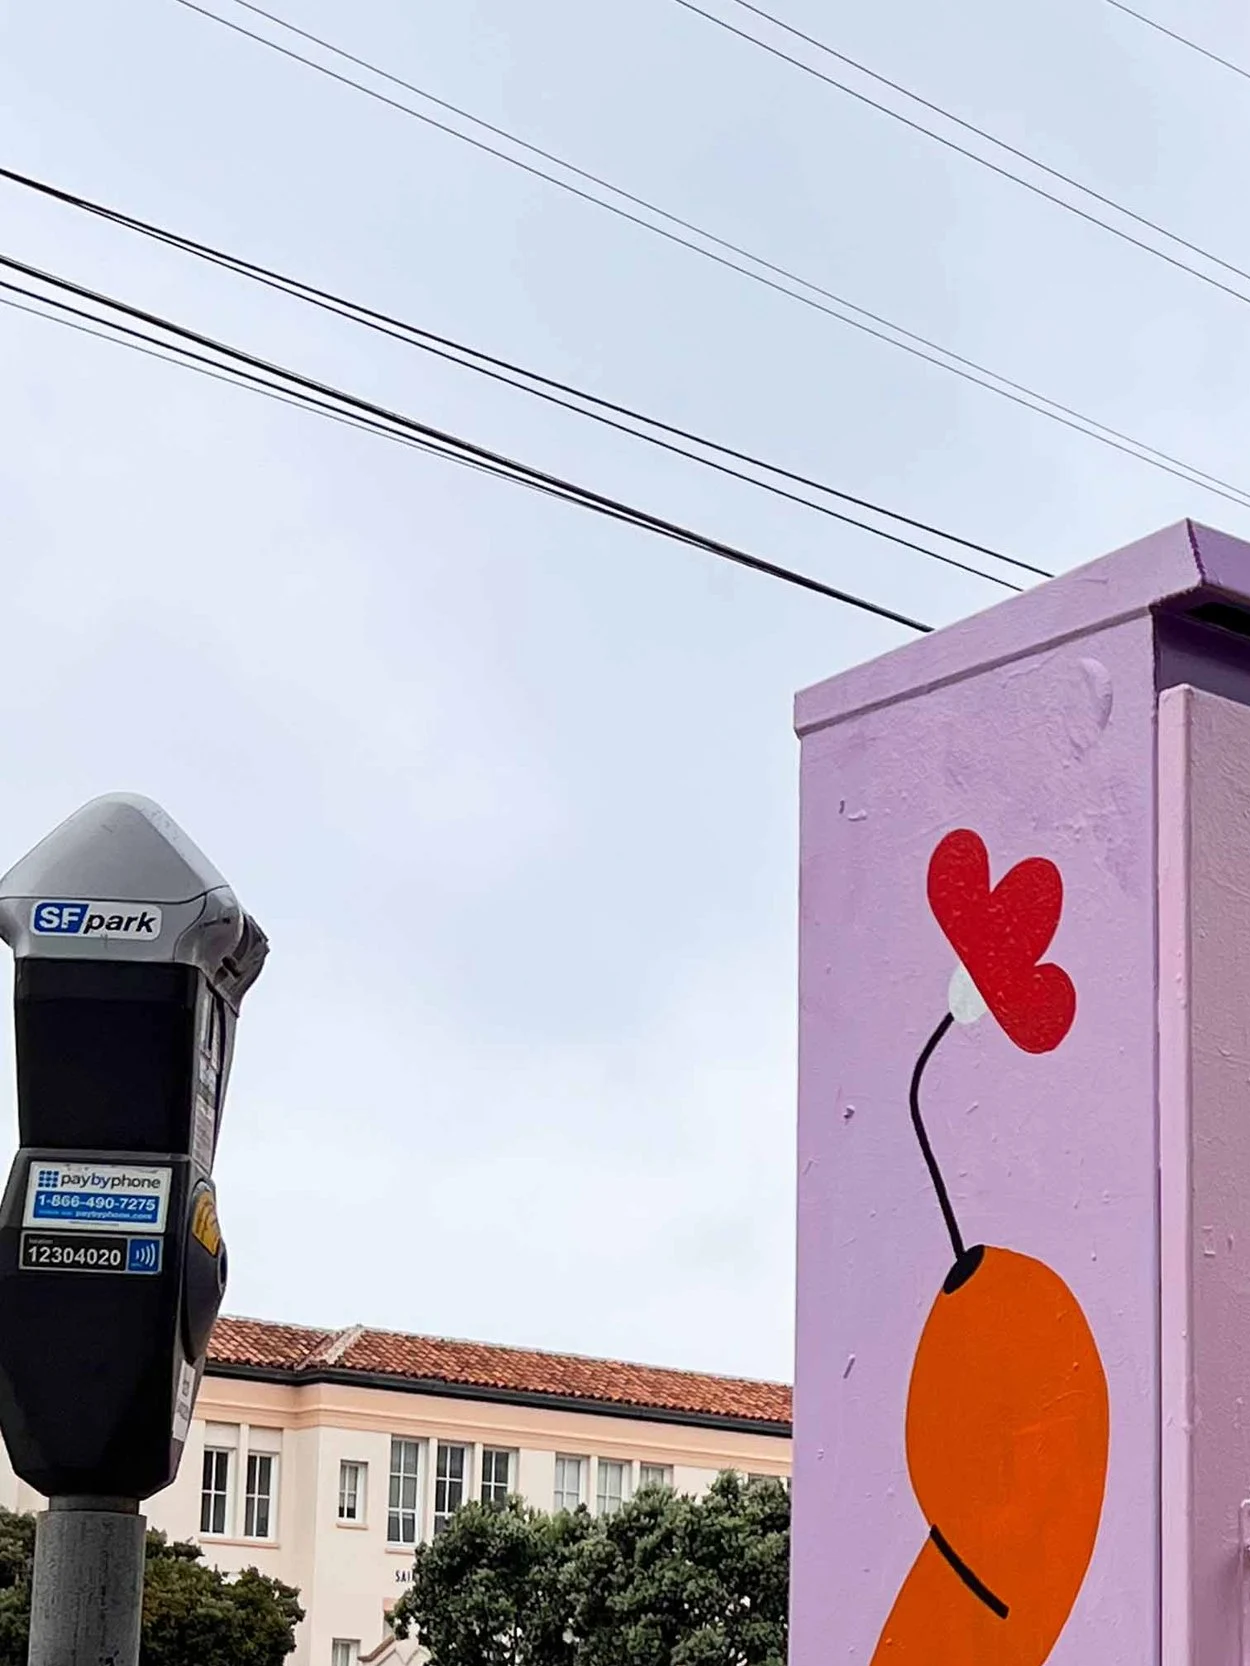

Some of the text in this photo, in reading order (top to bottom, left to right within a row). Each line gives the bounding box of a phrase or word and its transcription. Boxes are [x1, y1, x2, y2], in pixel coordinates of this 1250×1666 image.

[38, 905, 157, 935] SFpark
[60, 1172, 161, 1189] paybyphone
[37, 1194, 156, 1211] 1-866-490-7275
[28, 1246, 122, 1266] 12304020
